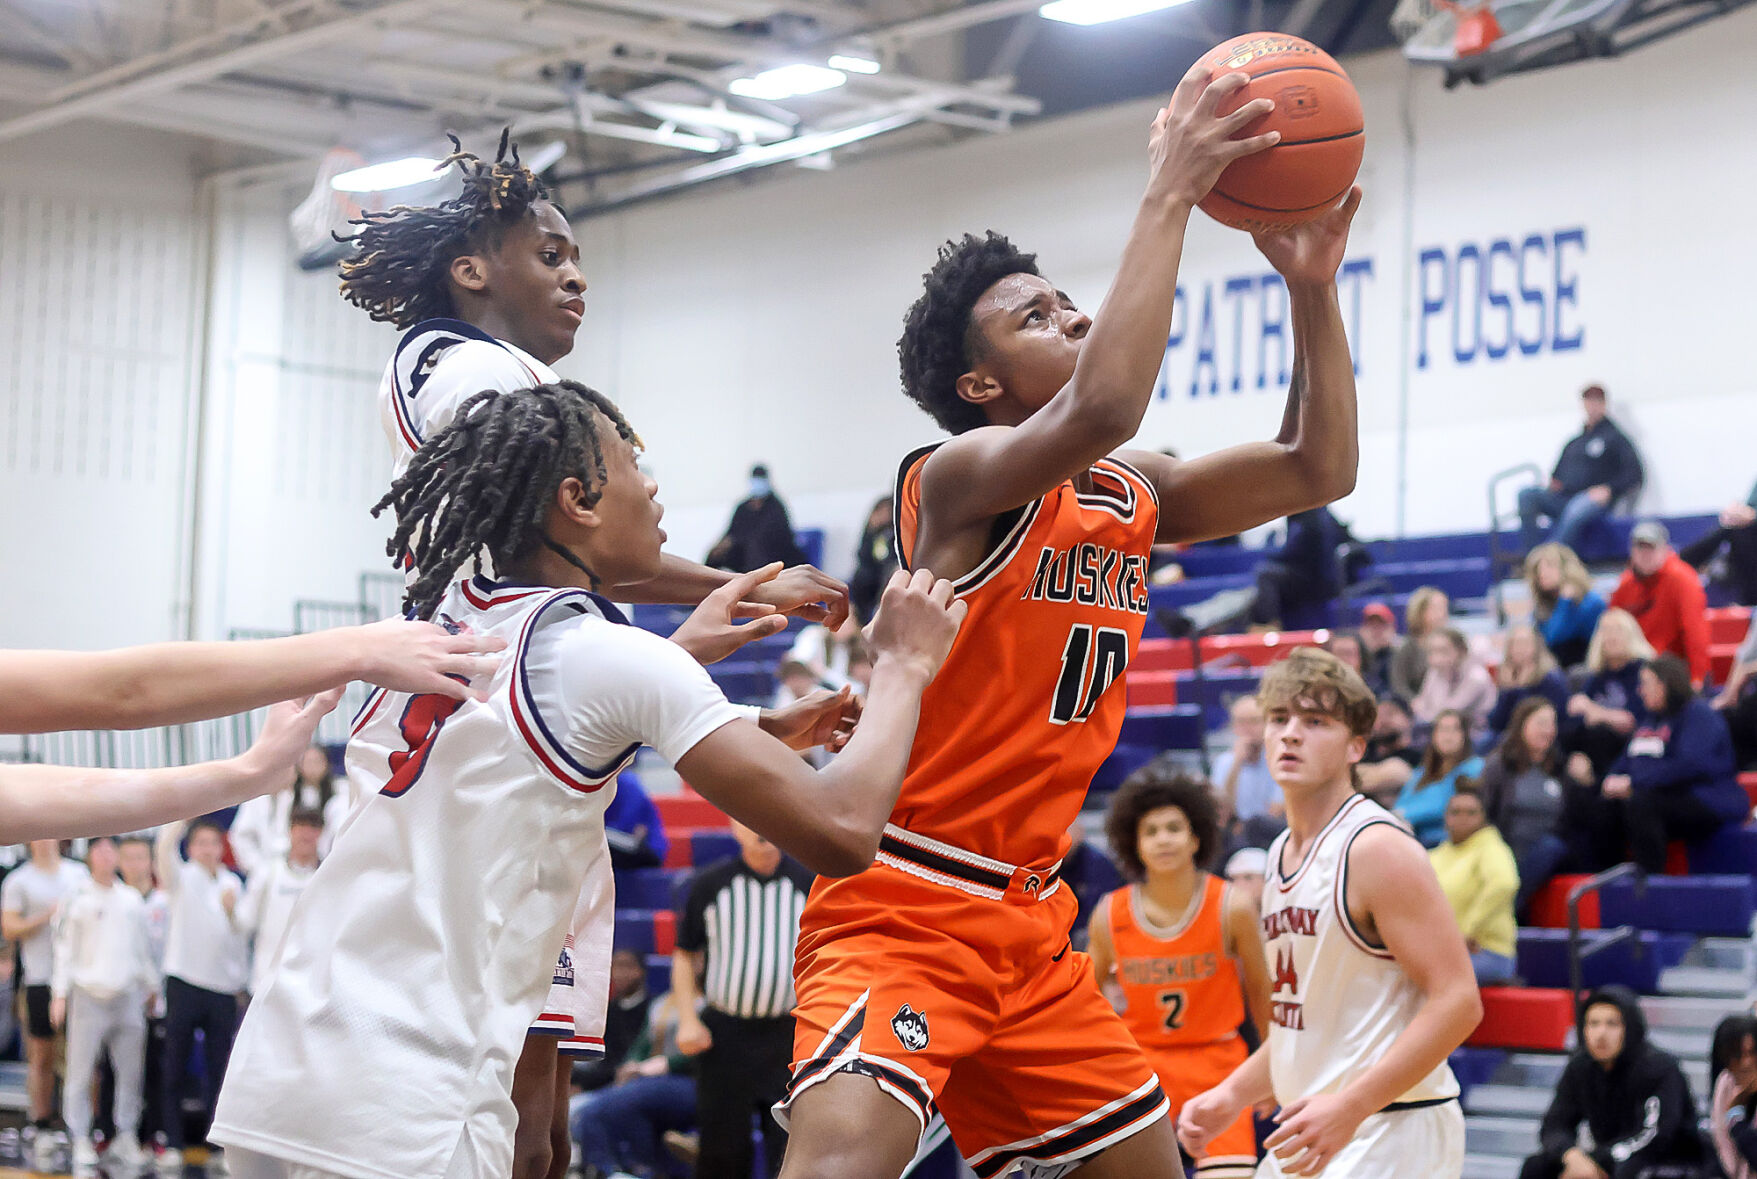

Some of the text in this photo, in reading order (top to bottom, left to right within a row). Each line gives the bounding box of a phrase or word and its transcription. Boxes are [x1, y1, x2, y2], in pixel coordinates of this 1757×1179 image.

[1158, 228, 1585, 400] PATRT POSSE
[1020, 542, 1150, 616] HUSKIES
[1049, 623, 1129, 725] 10
[1122, 952, 1217, 985] HUSKIES
[1157, 989, 1187, 1032] 2
